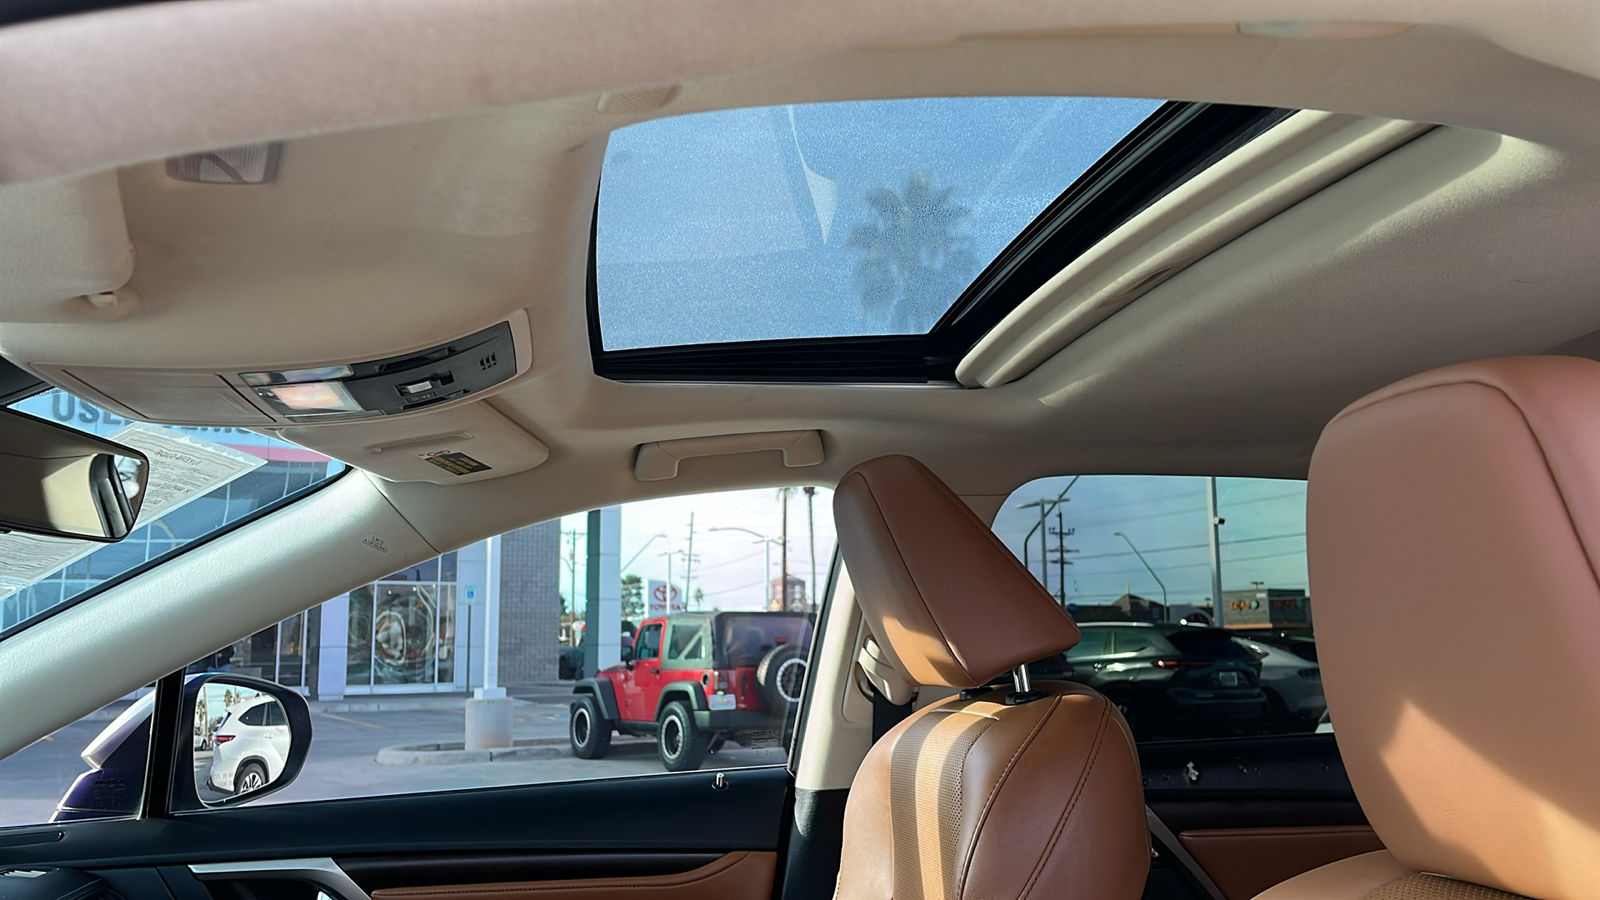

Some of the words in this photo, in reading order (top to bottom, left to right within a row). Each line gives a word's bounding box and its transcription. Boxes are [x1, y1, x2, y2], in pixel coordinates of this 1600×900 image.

[52, 393, 134, 425] US
[362, 538, 388, 552] AIRBAG
[371, 536, 385, 545] SRS
